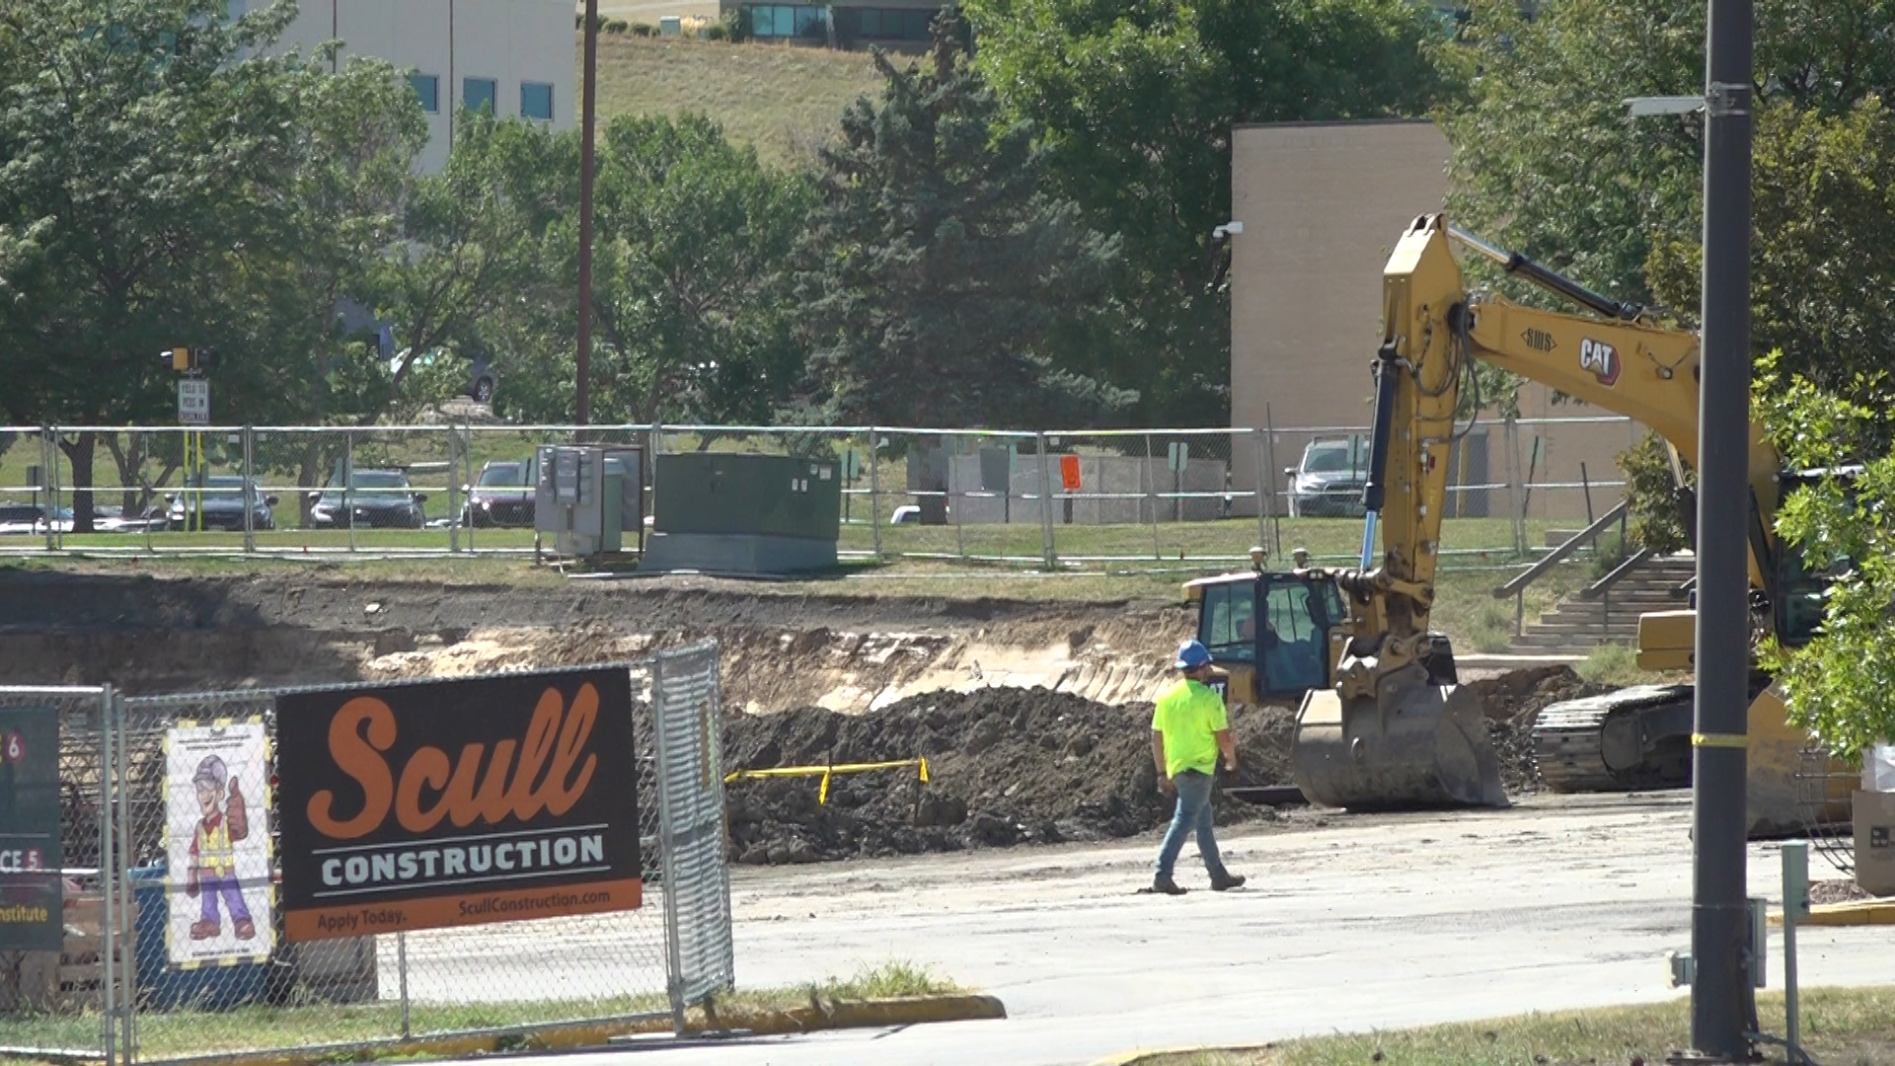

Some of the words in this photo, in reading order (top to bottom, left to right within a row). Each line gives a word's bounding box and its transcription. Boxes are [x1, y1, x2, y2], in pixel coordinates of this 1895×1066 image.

[1580, 338, 1612, 376] CAT
[8, 736, 20, 758] 6
[306, 682, 599, 839] Scull
[27, 851, 39, 871] 5
[321, 835, 605, 887] CONSTRUCTION
[317, 911, 359, 932] Apply
[361, 909, 408, 926] Today.
[458, 891, 611, 917] ScullConstruction.com
